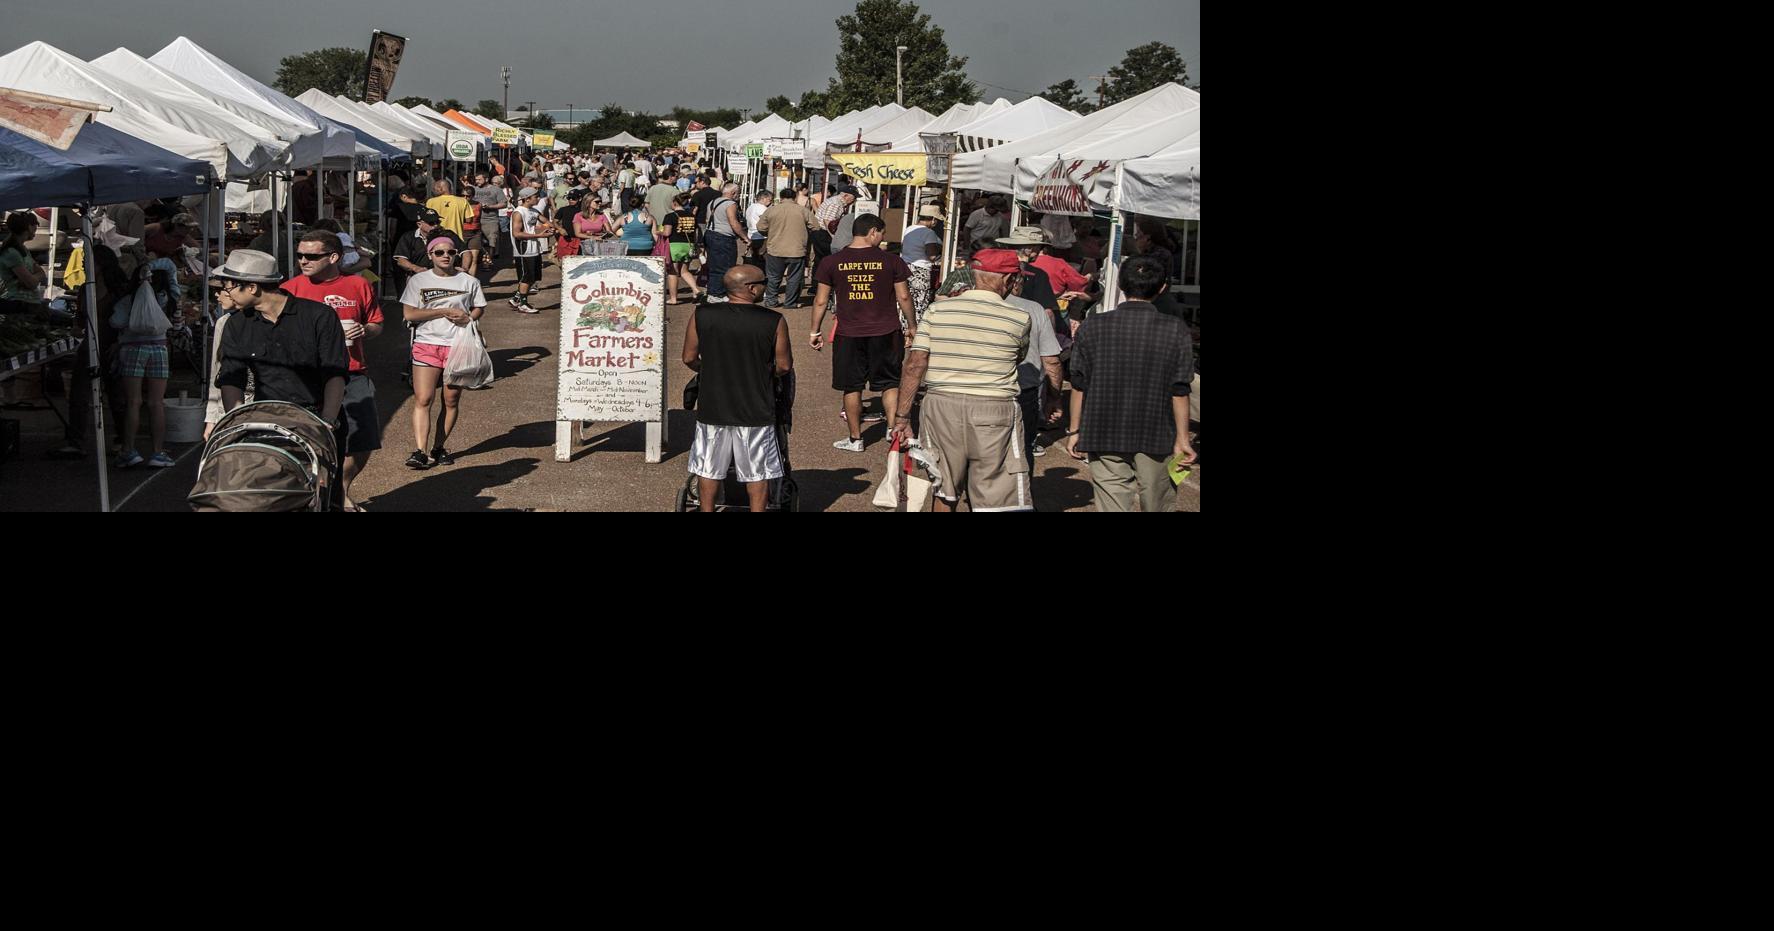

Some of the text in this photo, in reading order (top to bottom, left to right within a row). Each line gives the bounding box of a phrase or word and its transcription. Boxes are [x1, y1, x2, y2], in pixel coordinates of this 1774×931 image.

[747, 149, 763, 158] LAMB
[877, 164, 915, 180] Cheese
[838, 262, 863, 271] CARPE
[847, 274, 875, 282] SEIZE
[851, 283, 871, 291] THE
[571, 281, 651, 306] Columbia
[848, 291, 874, 300] ROAD
[572, 327, 654, 349] Farmers
[565, 350, 640, 368] Market
[598, 369, 618, 378] Open
[575, 377, 611, 387] Saturdays
[617, 378, 623, 386] 8
